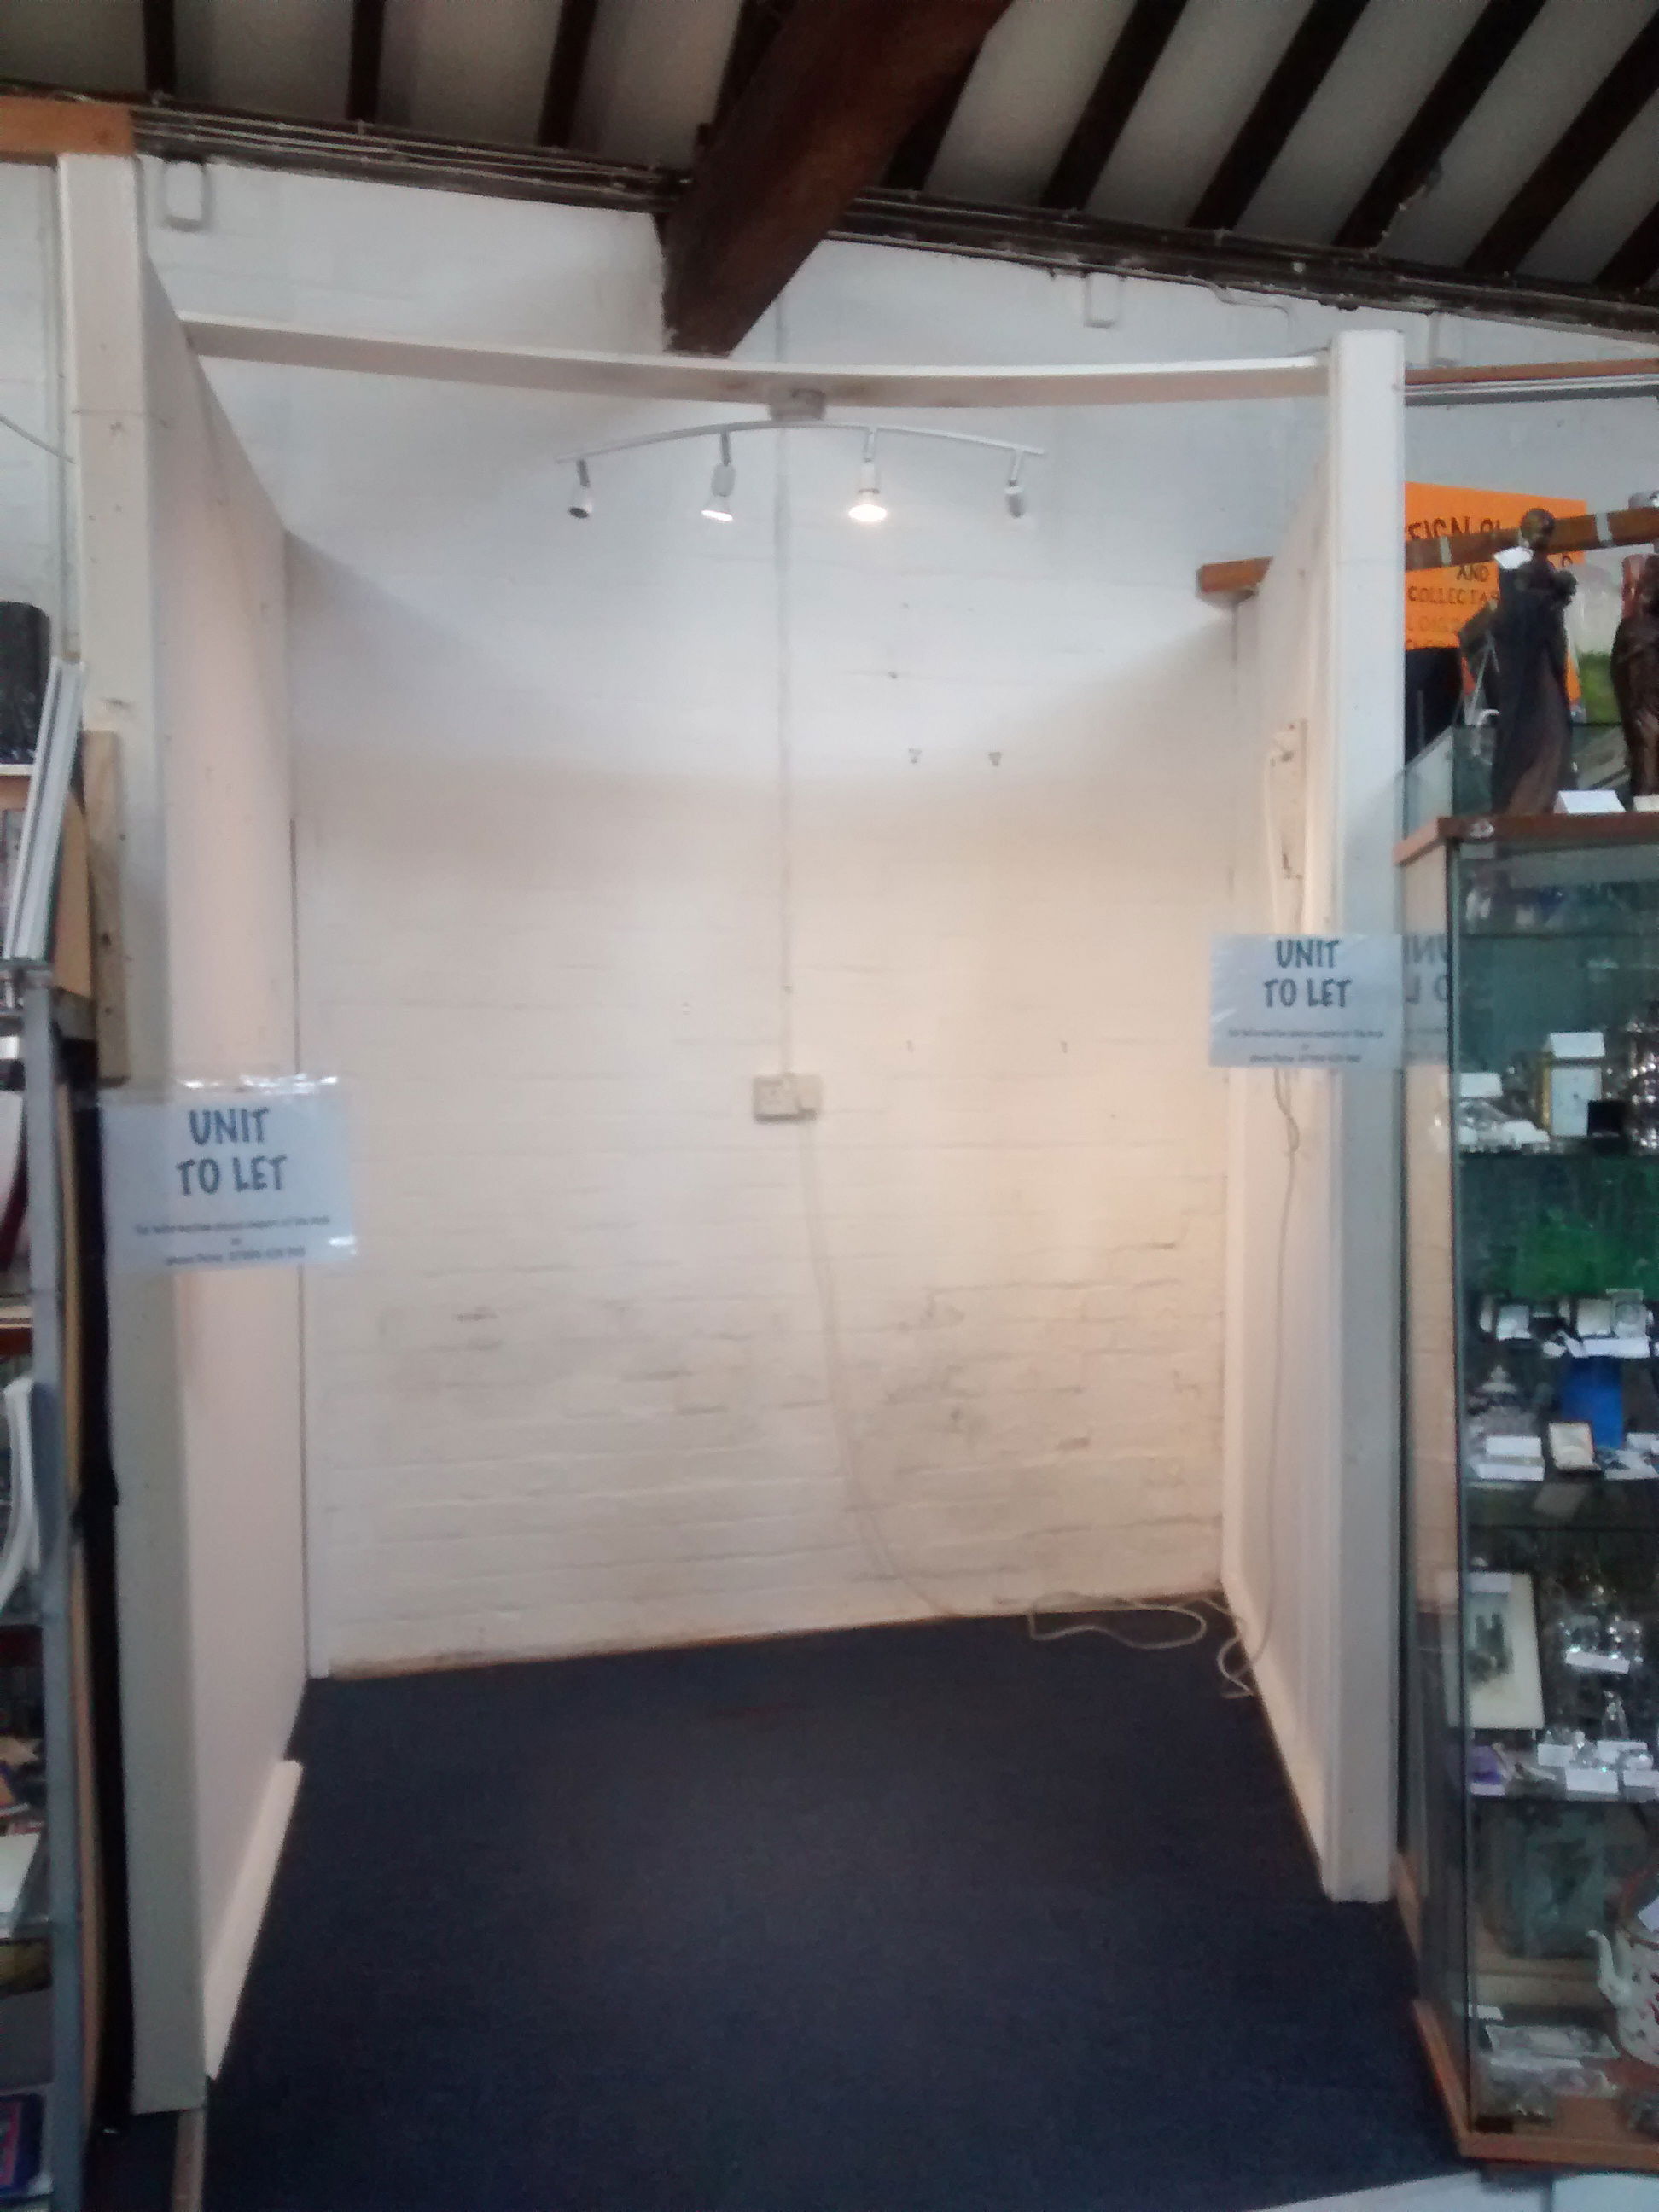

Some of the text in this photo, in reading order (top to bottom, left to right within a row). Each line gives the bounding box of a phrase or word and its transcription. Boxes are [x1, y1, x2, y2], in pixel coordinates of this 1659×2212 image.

[1276, 938, 1340, 969] UNIT
[1263, 979, 1353, 1007] TO LET
[189, 1106, 270, 1145] UNIT
[175, 1155, 288, 1196] TO LET
